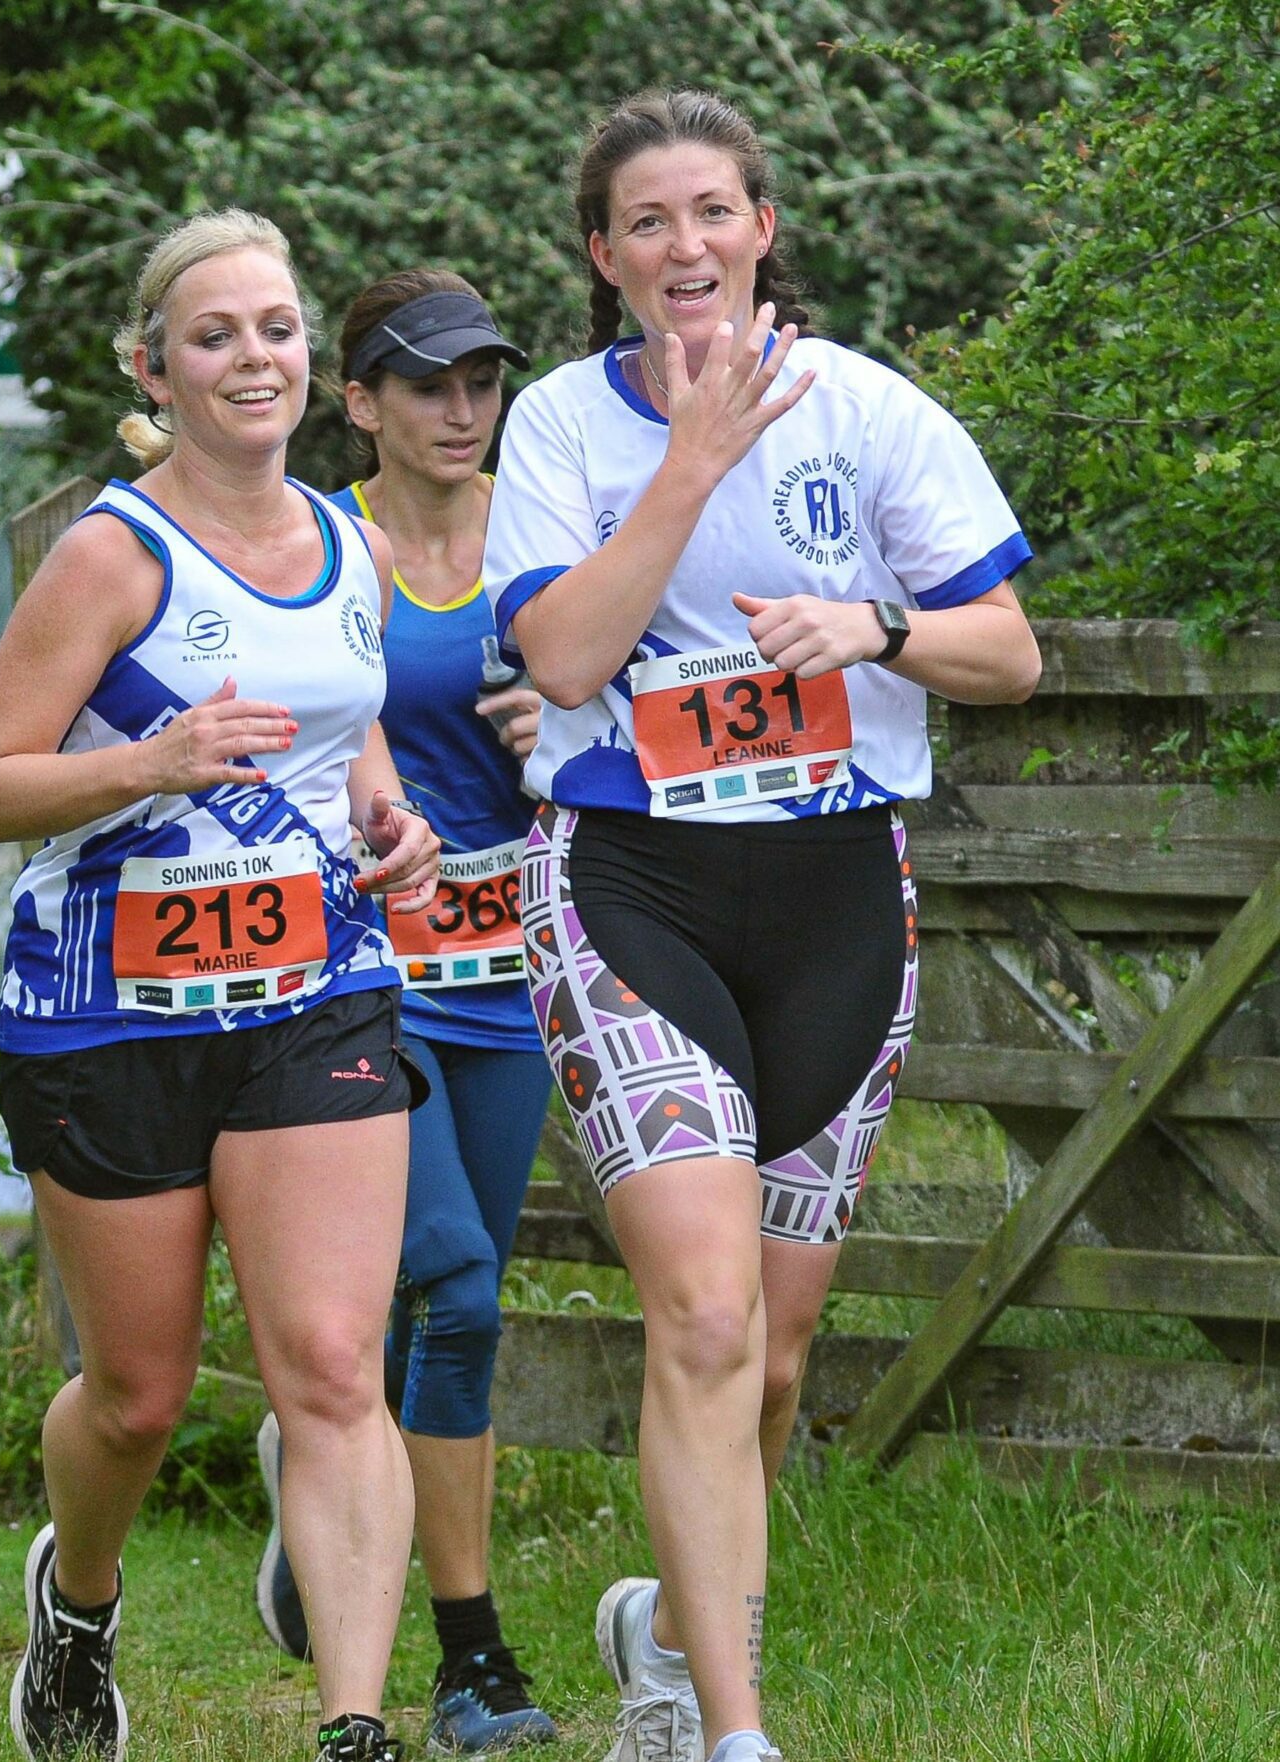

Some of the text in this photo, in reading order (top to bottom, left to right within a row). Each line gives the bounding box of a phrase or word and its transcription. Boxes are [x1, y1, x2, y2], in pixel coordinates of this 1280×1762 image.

[772, 457, 822, 508] READING
[774, 516, 829, 567] JOGGERS
[182, 653, 238, 663] SCIMITAR
[678, 650, 757, 680] SONNING
[678, 671, 805, 748] 131
[712, 738, 795, 767] LEANNE
[161, 855, 274, 886] SONNING 10K
[495, 850, 517, 869] 10K
[154, 882, 287, 957] 213
[193, 951, 258, 973] MARIE
